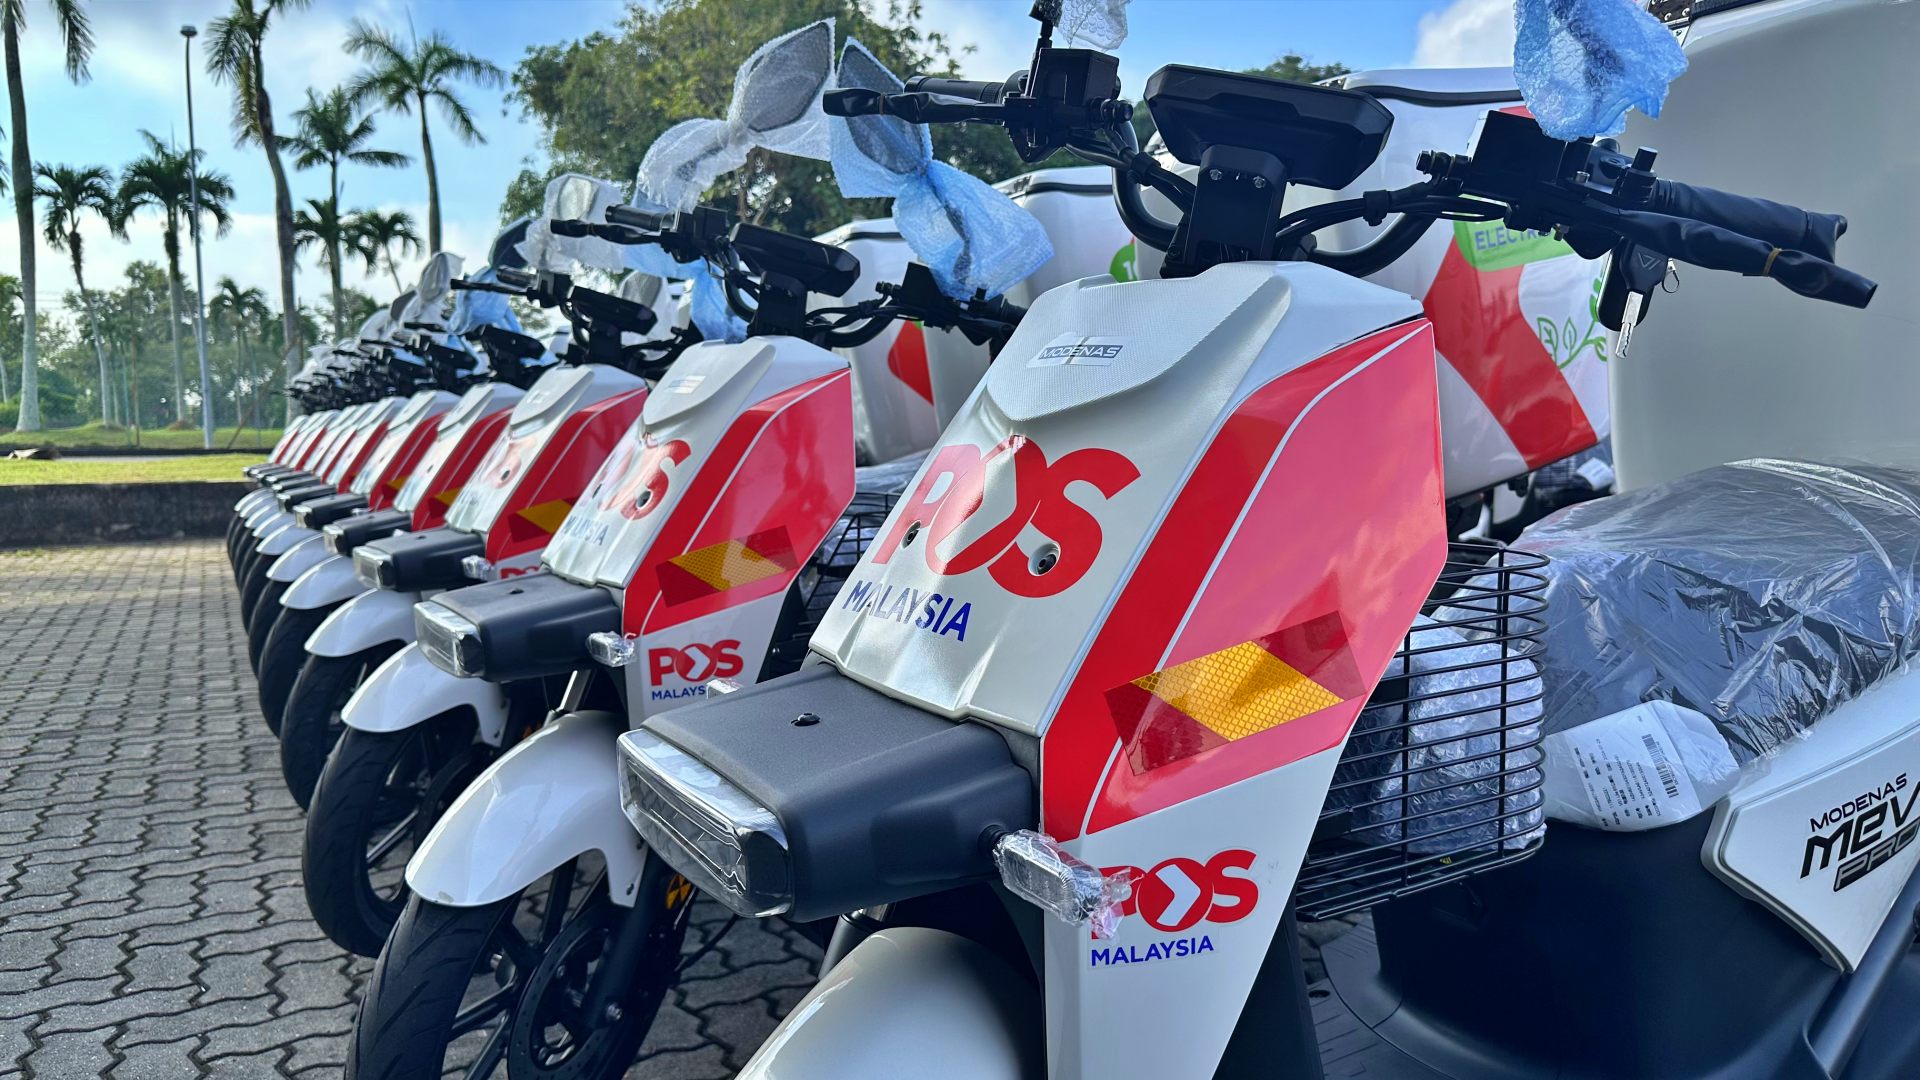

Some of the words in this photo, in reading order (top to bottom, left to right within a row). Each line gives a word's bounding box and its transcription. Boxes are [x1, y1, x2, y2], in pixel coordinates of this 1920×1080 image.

[1039, 345, 1120, 359] MODENAS
[871, 434, 1142, 598] POS
[842, 580, 973, 642] MALAYSIA
[648, 639, 744, 686] POS
[1809, 772, 1908, 833] MODENAS
[1091, 935, 1214, 967] MALAYSIA
